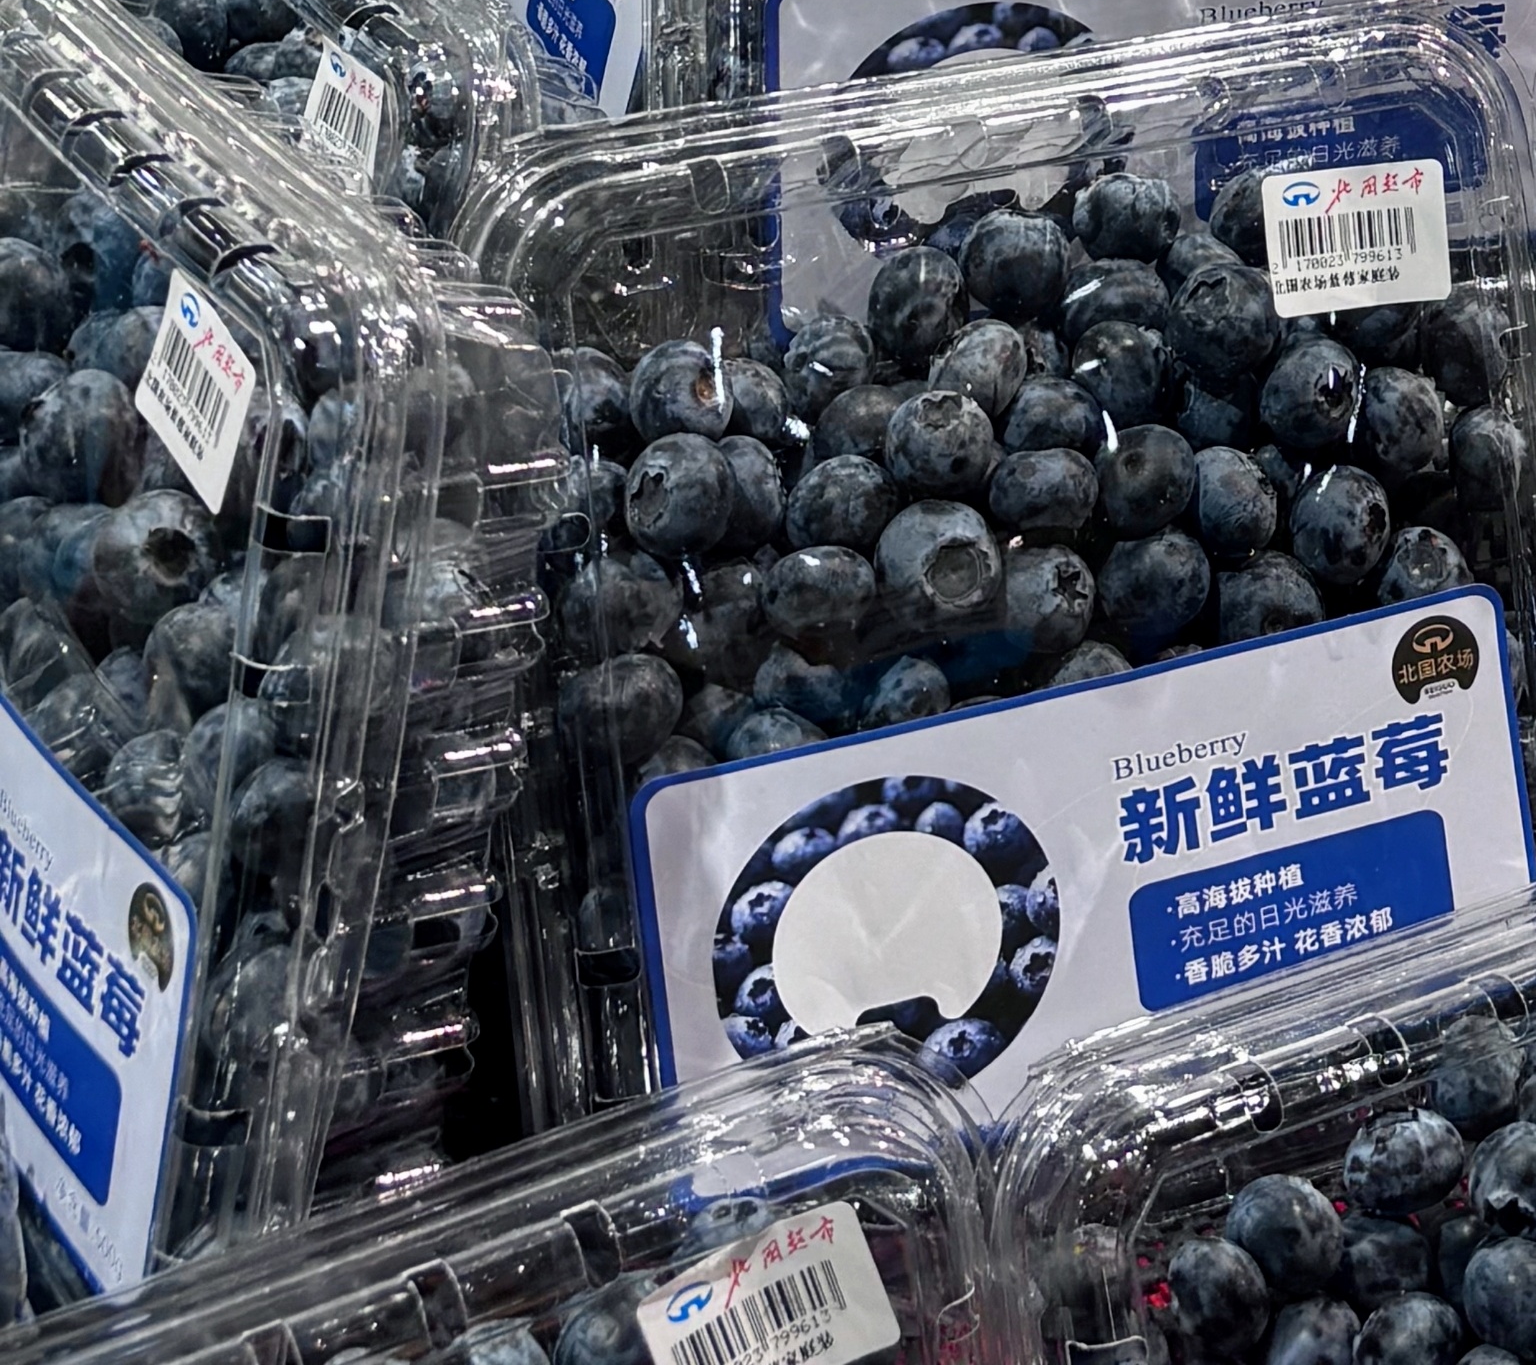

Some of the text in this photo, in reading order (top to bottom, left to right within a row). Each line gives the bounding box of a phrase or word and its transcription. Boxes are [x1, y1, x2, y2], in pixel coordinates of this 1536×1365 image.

[1272, 263, 1279, 275] 2
[1353, 248, 1403, 264] 799613
[1398, 649, 1473, 686] 北国农场
[1112, 731, 1248, 781] Blueberry
[1119, 712, 1450, 865] 新鲜蓝莓
[1175, 863, 1304, 918] 高海拔种植
[1180, 883, 1358, 953] 充足的日光滋养
[0, 829, 146, 1058] 新鲜蓝莓
[1184, 907, 1394, 984] 香脆多汁 花香浓郁
[770, 1309, 833, 1349] 799613
